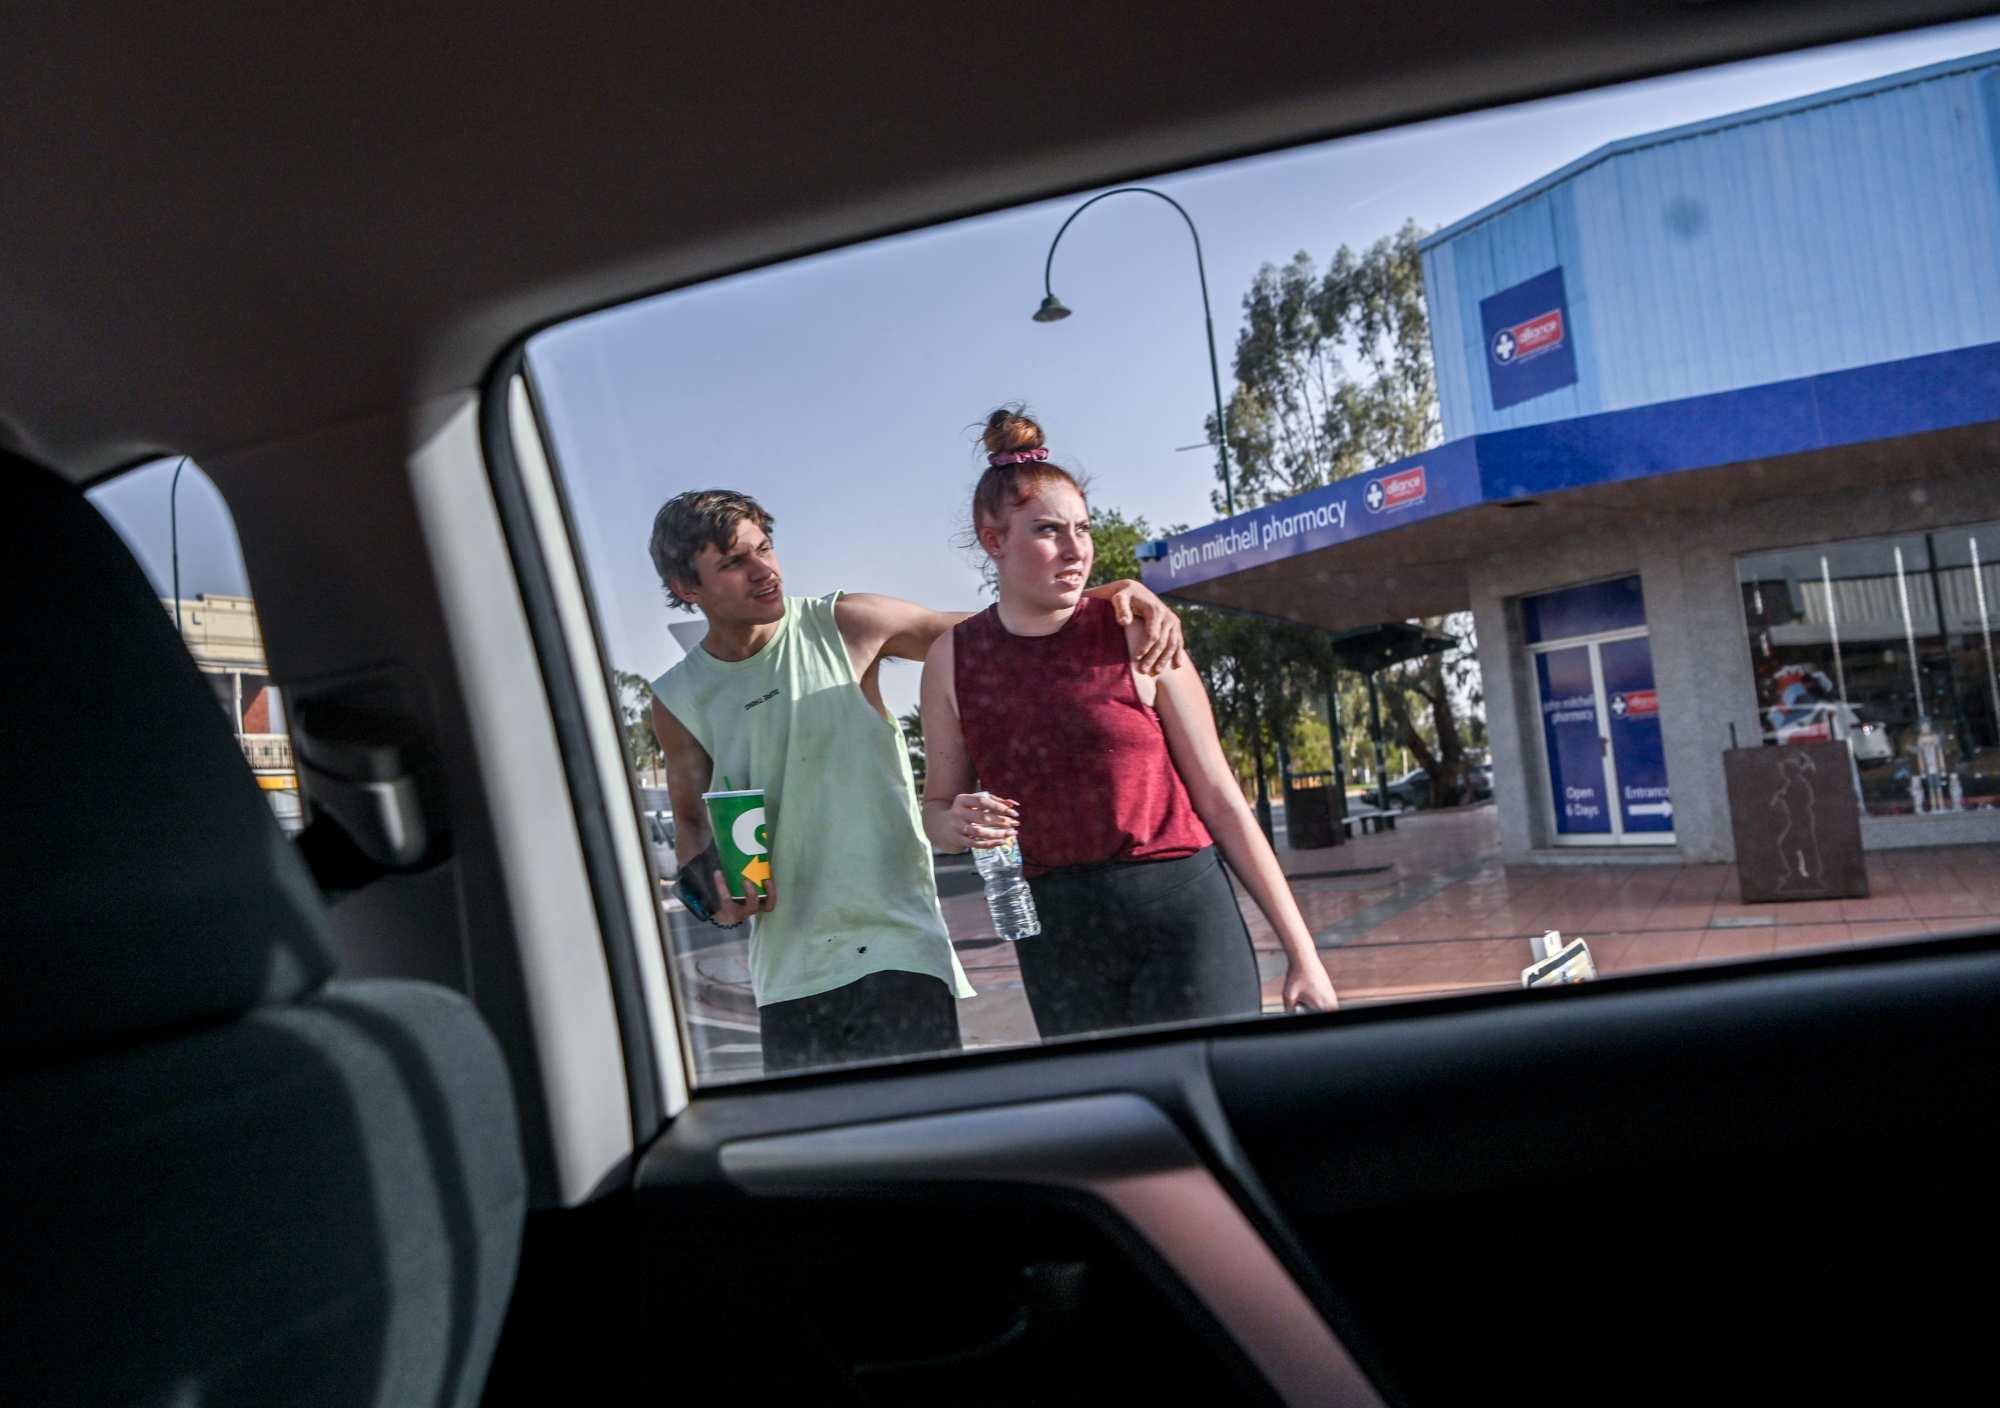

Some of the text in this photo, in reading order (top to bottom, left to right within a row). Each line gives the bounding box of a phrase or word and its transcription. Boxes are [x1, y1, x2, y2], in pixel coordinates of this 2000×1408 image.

[1169, 500, 1347, 577] john mitchell pharmacy
[1565, 786, 1594, 800] Open
[1575, 803, 1600, 818] Days
